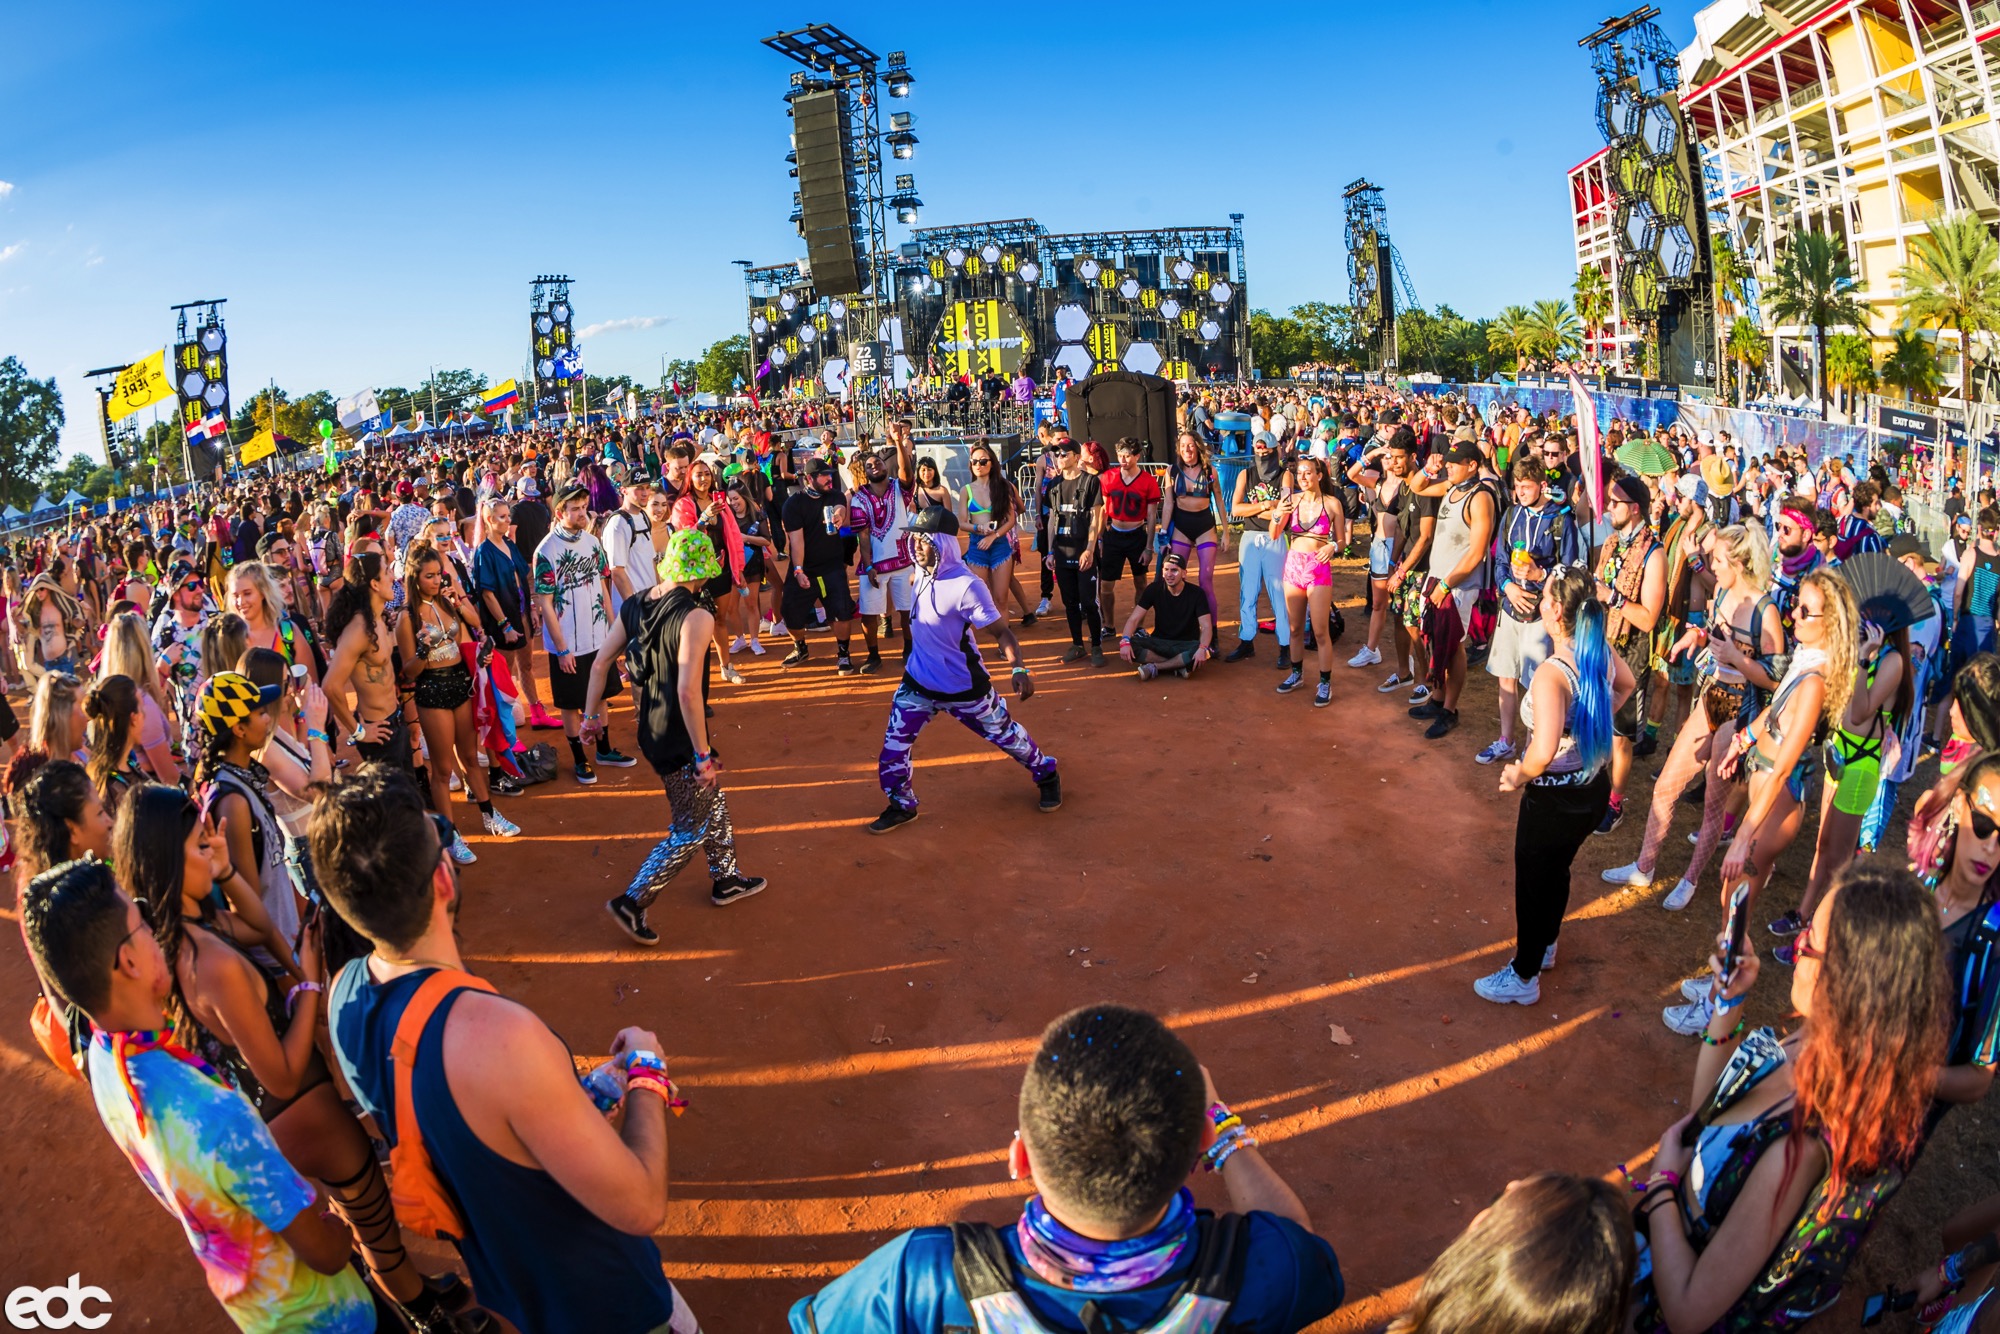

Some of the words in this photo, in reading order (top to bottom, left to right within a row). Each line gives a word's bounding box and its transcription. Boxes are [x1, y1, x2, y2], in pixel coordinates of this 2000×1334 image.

[856, 346, 871, 359] Z2
[853, 359, 877, 371] SE5
[1892, 416, 1908, 428] EXIT
[1908, 418, 1926, 430] ONLY
[1962, 399, 1994, 441] VIP
